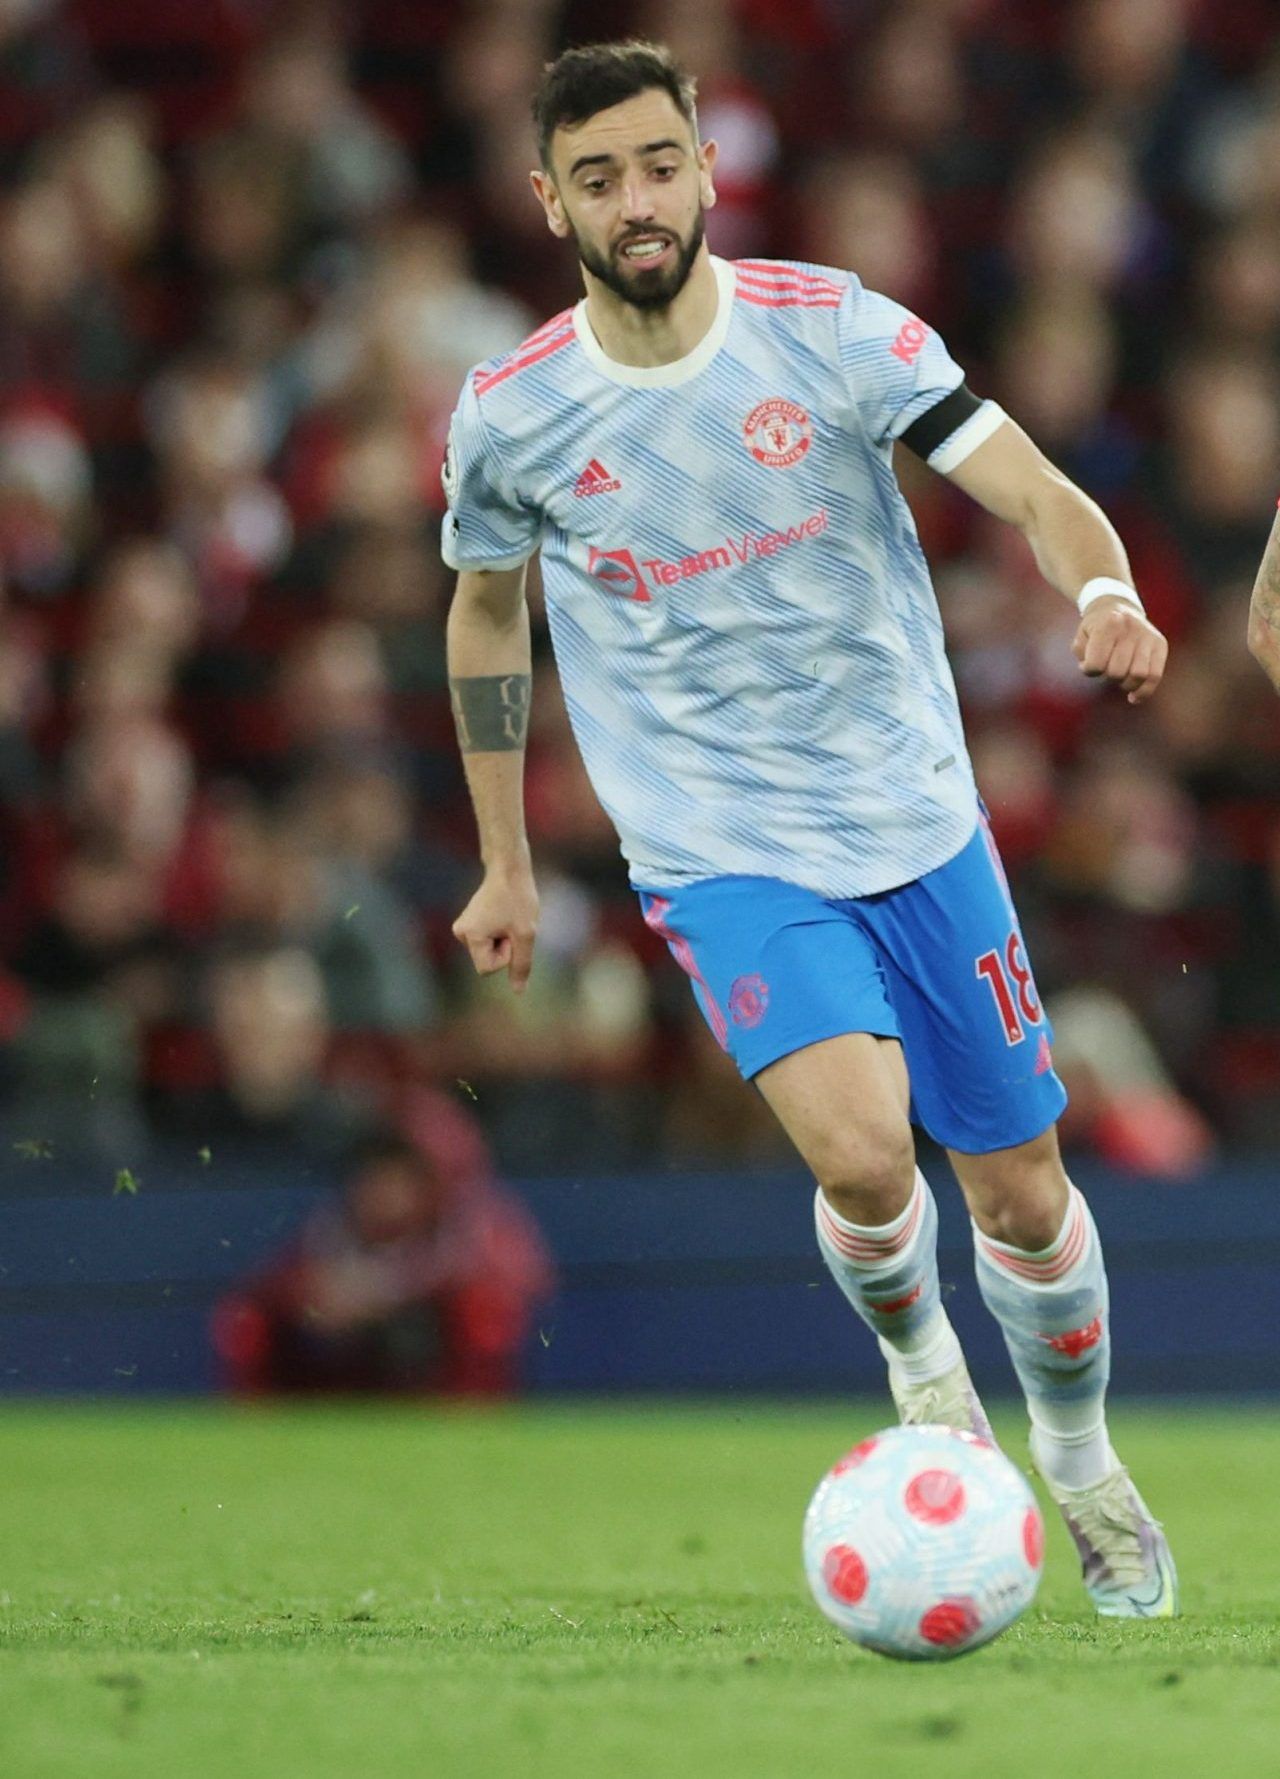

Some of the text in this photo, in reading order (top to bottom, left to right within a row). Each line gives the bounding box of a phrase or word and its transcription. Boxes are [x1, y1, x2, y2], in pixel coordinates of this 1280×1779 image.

[747, 402, 804, 431] MANCHESTER
[763, 447, 804, 464] UNITED
[574, 479, 622, 498] adidas
[641, 507, 829, 586] TeamViewer
[975, 928, 1043, 1047] 18
